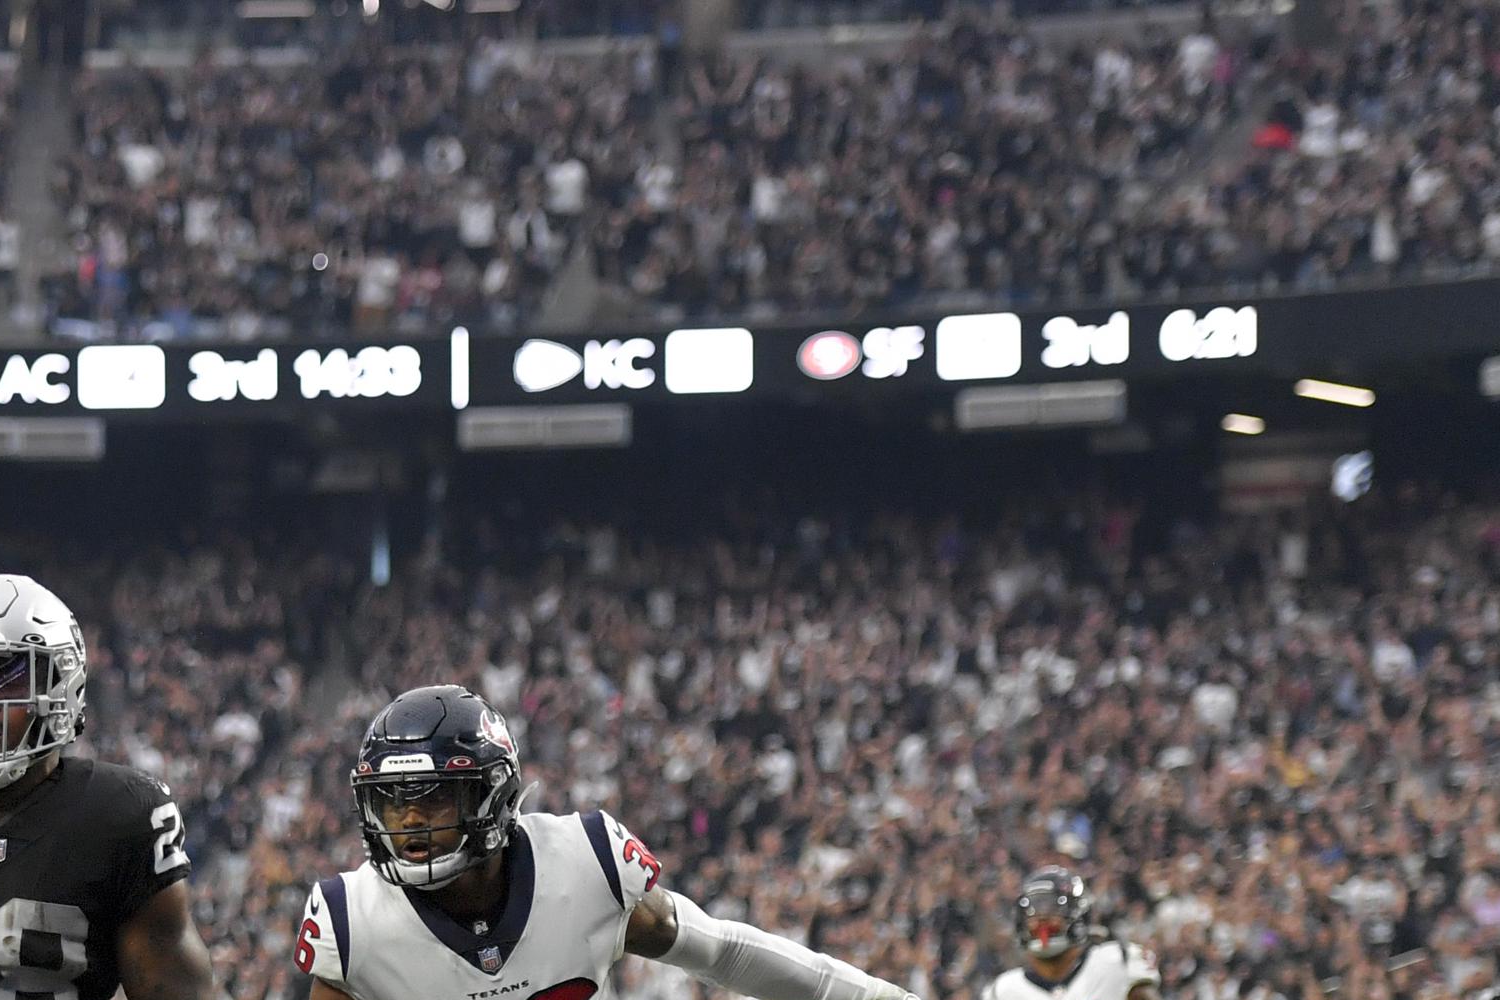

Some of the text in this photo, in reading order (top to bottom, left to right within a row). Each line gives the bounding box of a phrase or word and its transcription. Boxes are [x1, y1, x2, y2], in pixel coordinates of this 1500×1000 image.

[188, 349, 277, 401] 3rd
[583, 338, 655, 389] KC
[862, 326, 924, 378] SF
[1042, 312, 1129, 368] 3rd
[623, 833, 661, 892] 3
[294, 918, 321, 975] 6
[467, 980, 529, 1000] TEXANS
